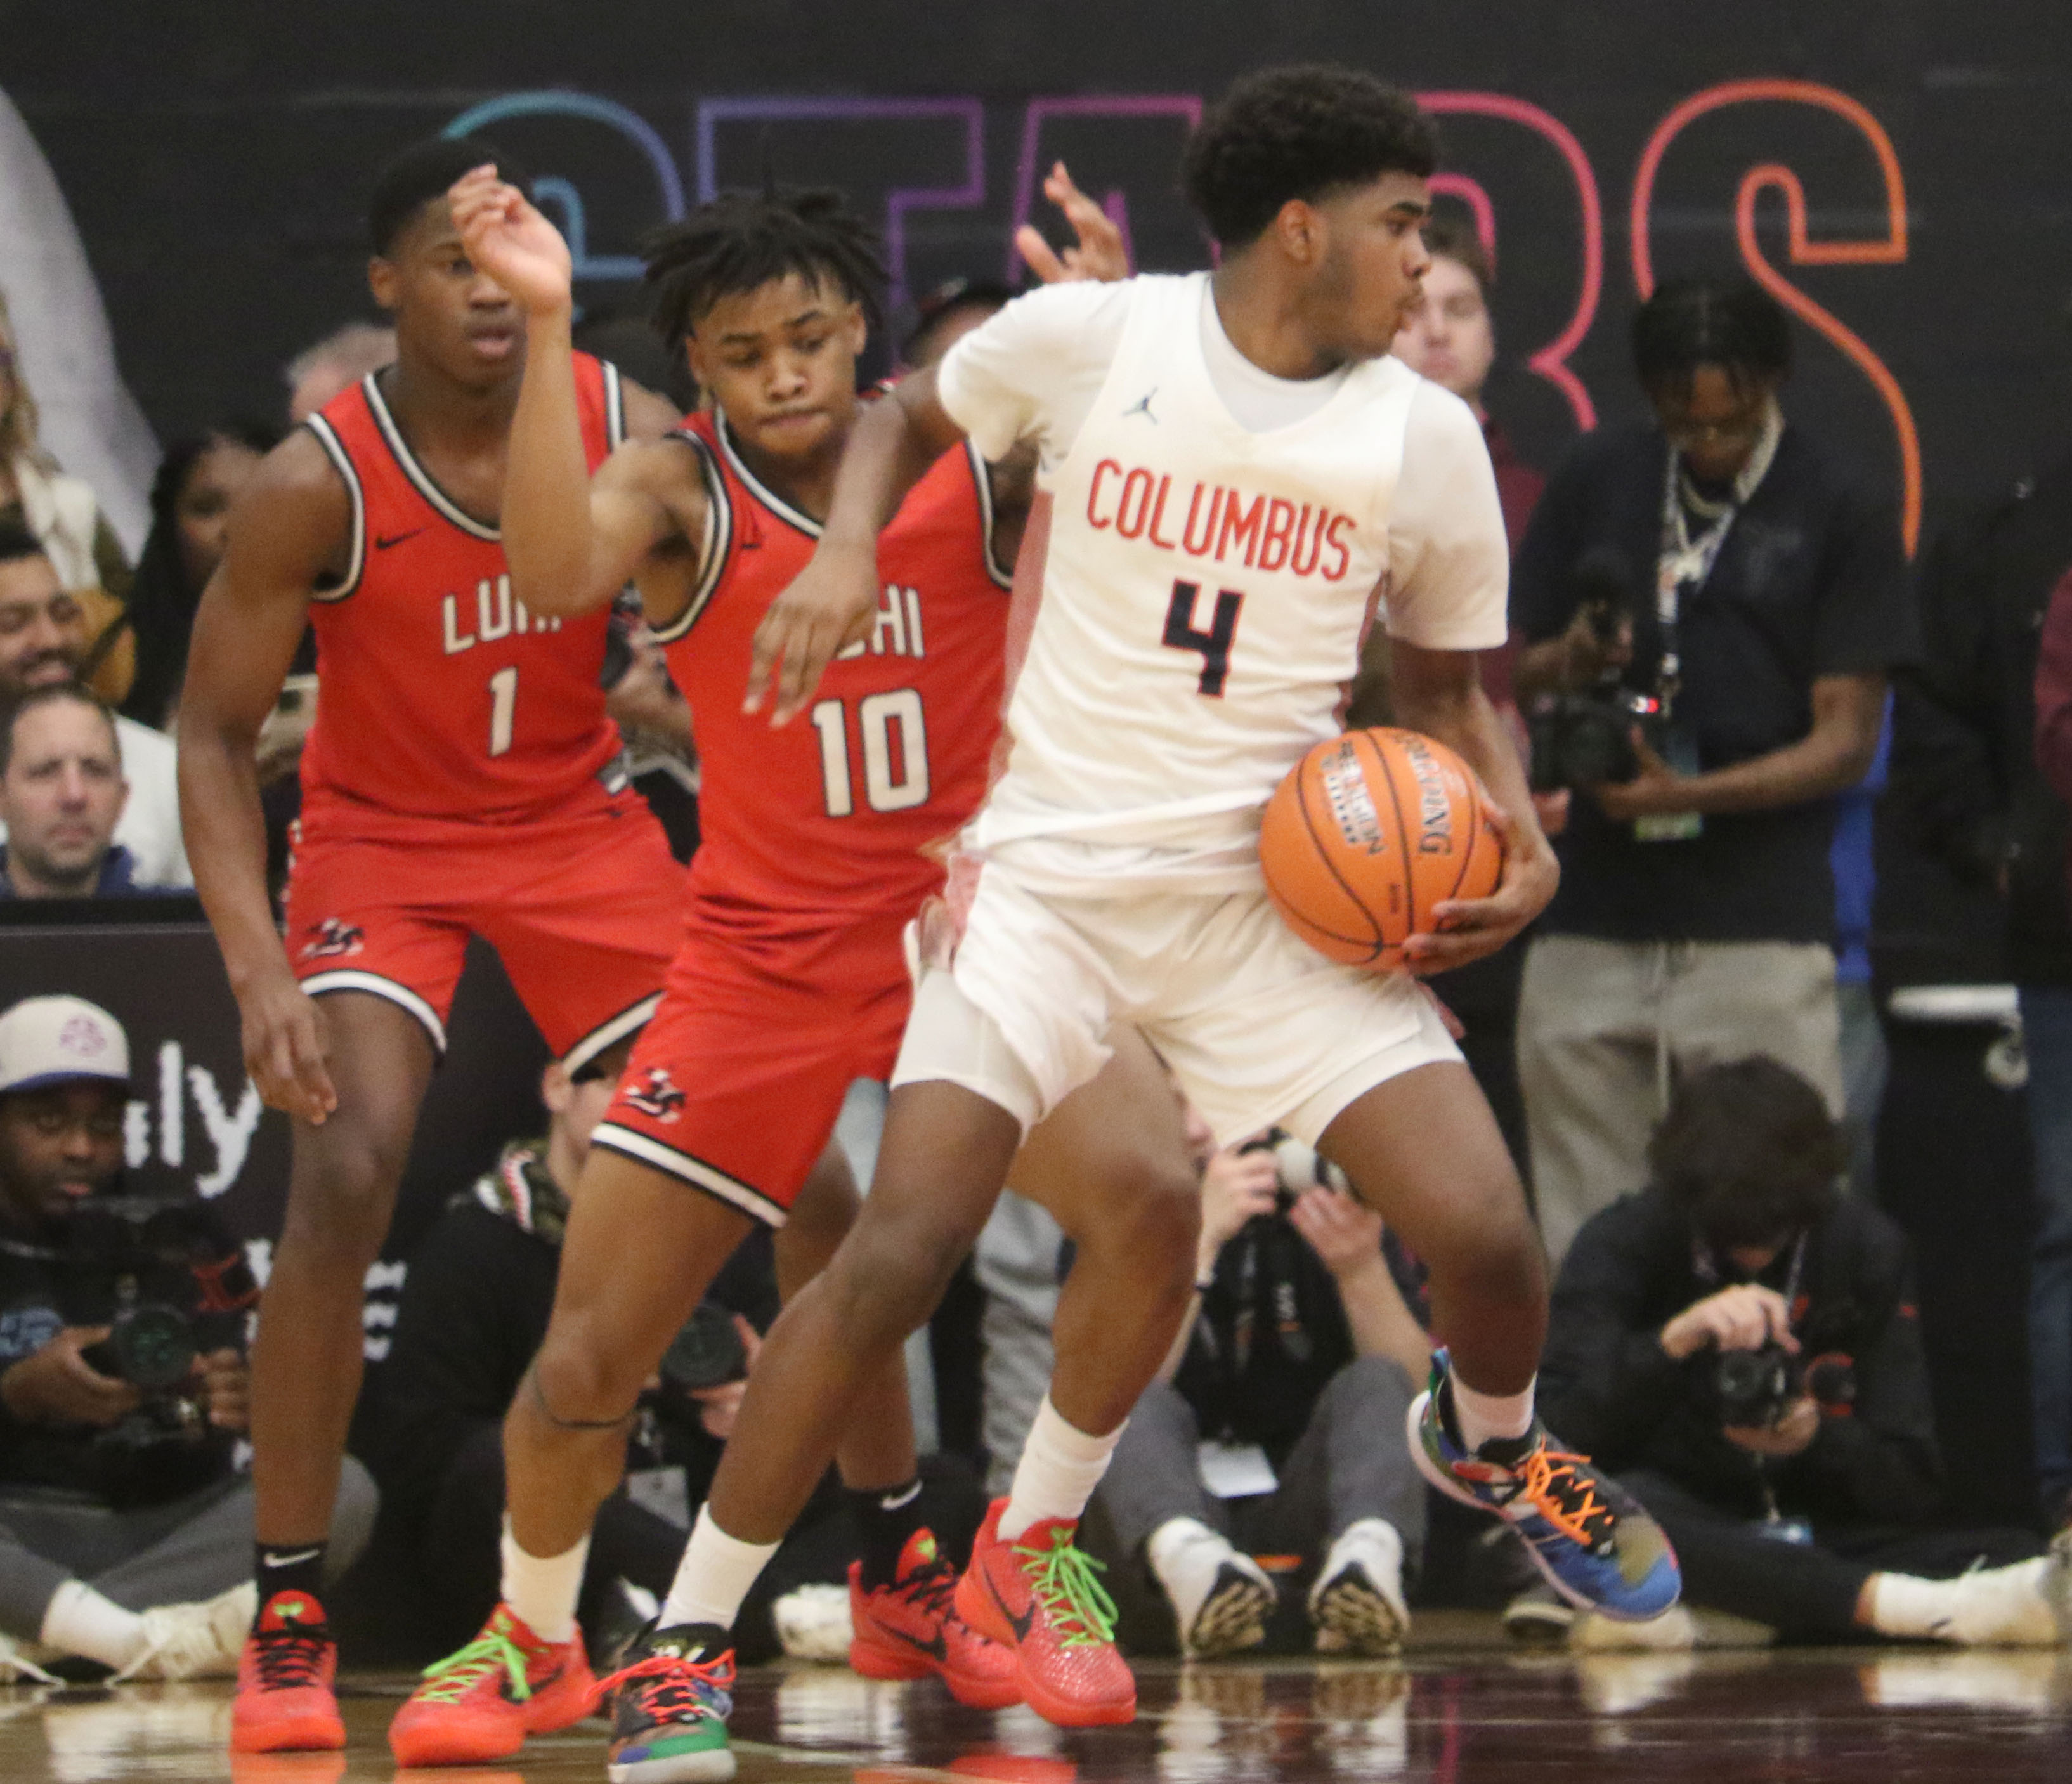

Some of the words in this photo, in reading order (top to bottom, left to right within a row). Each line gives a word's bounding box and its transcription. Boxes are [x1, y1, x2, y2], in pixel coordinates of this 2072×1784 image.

[1086, 457, 1357, 582] COLUMBUS
[1160, 578, 1245, 699] 4
[489, 665, 519, 758] 1
[811, 687, 930, 817] 10
